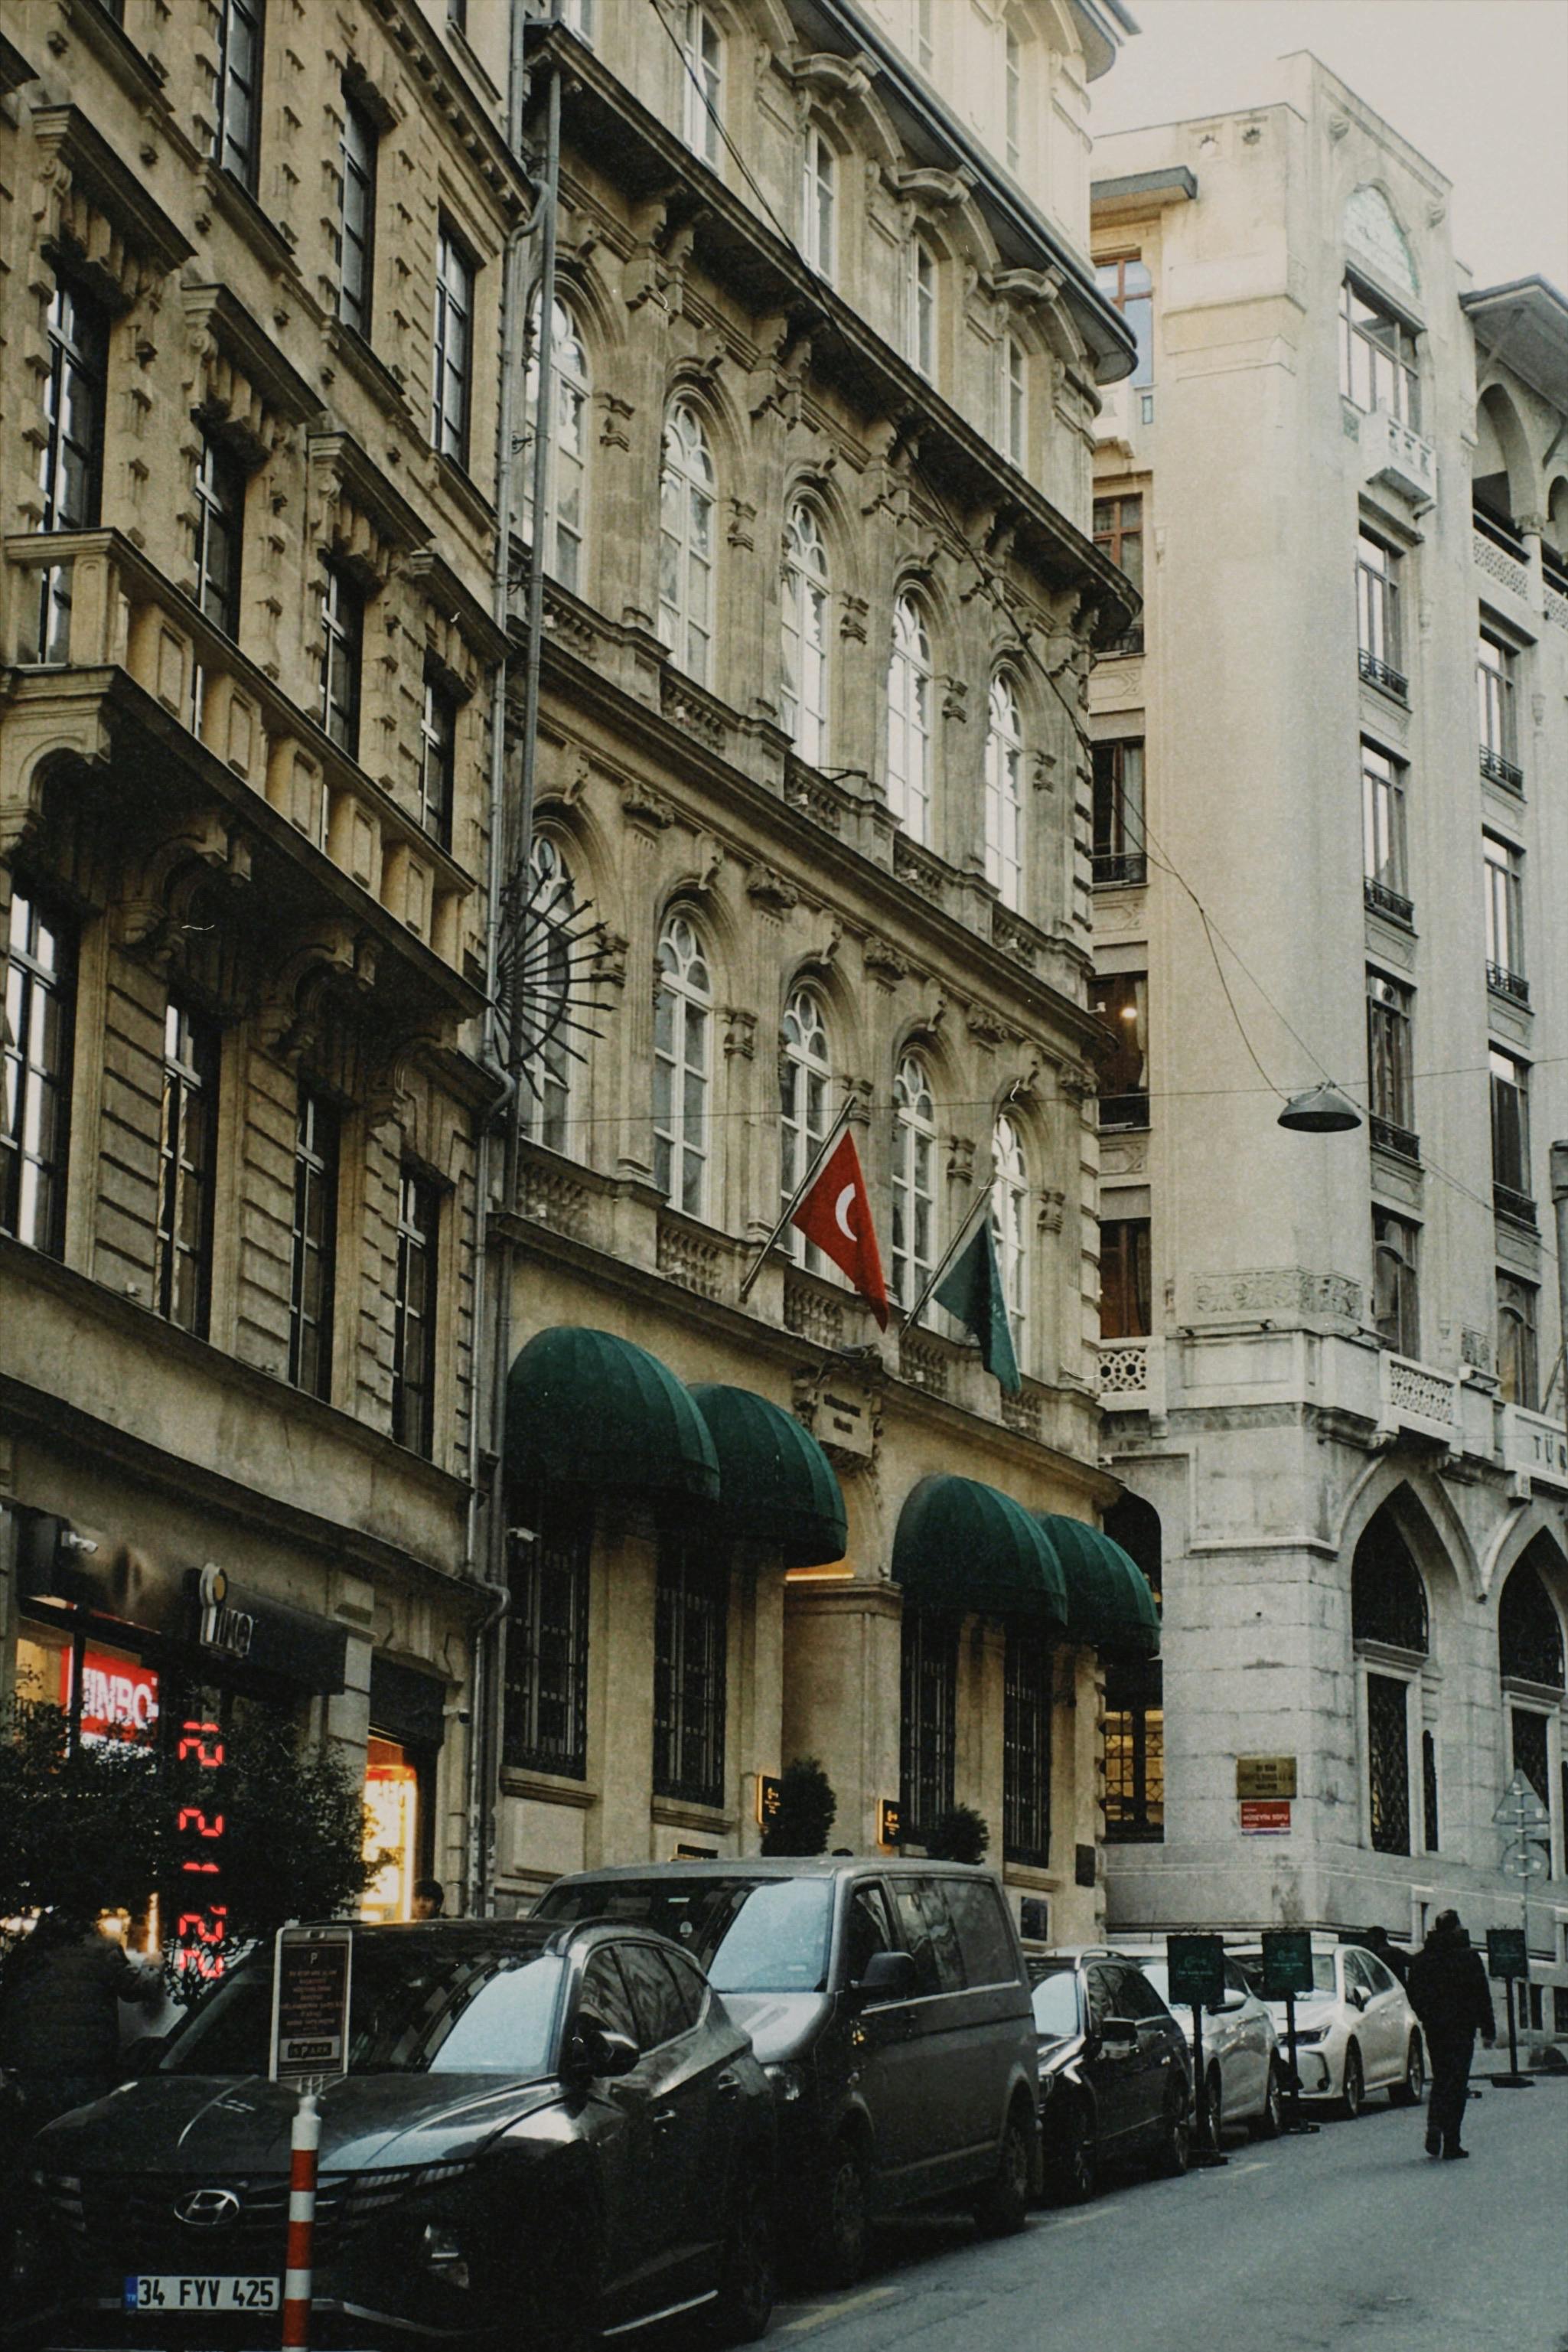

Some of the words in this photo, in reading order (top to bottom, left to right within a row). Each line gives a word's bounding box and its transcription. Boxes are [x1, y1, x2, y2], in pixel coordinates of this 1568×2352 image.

[139, 2279, 165, 2306] 34
[179, 2279, 220, 2307] FYV
[232, 2279, 274, 2307] 425
